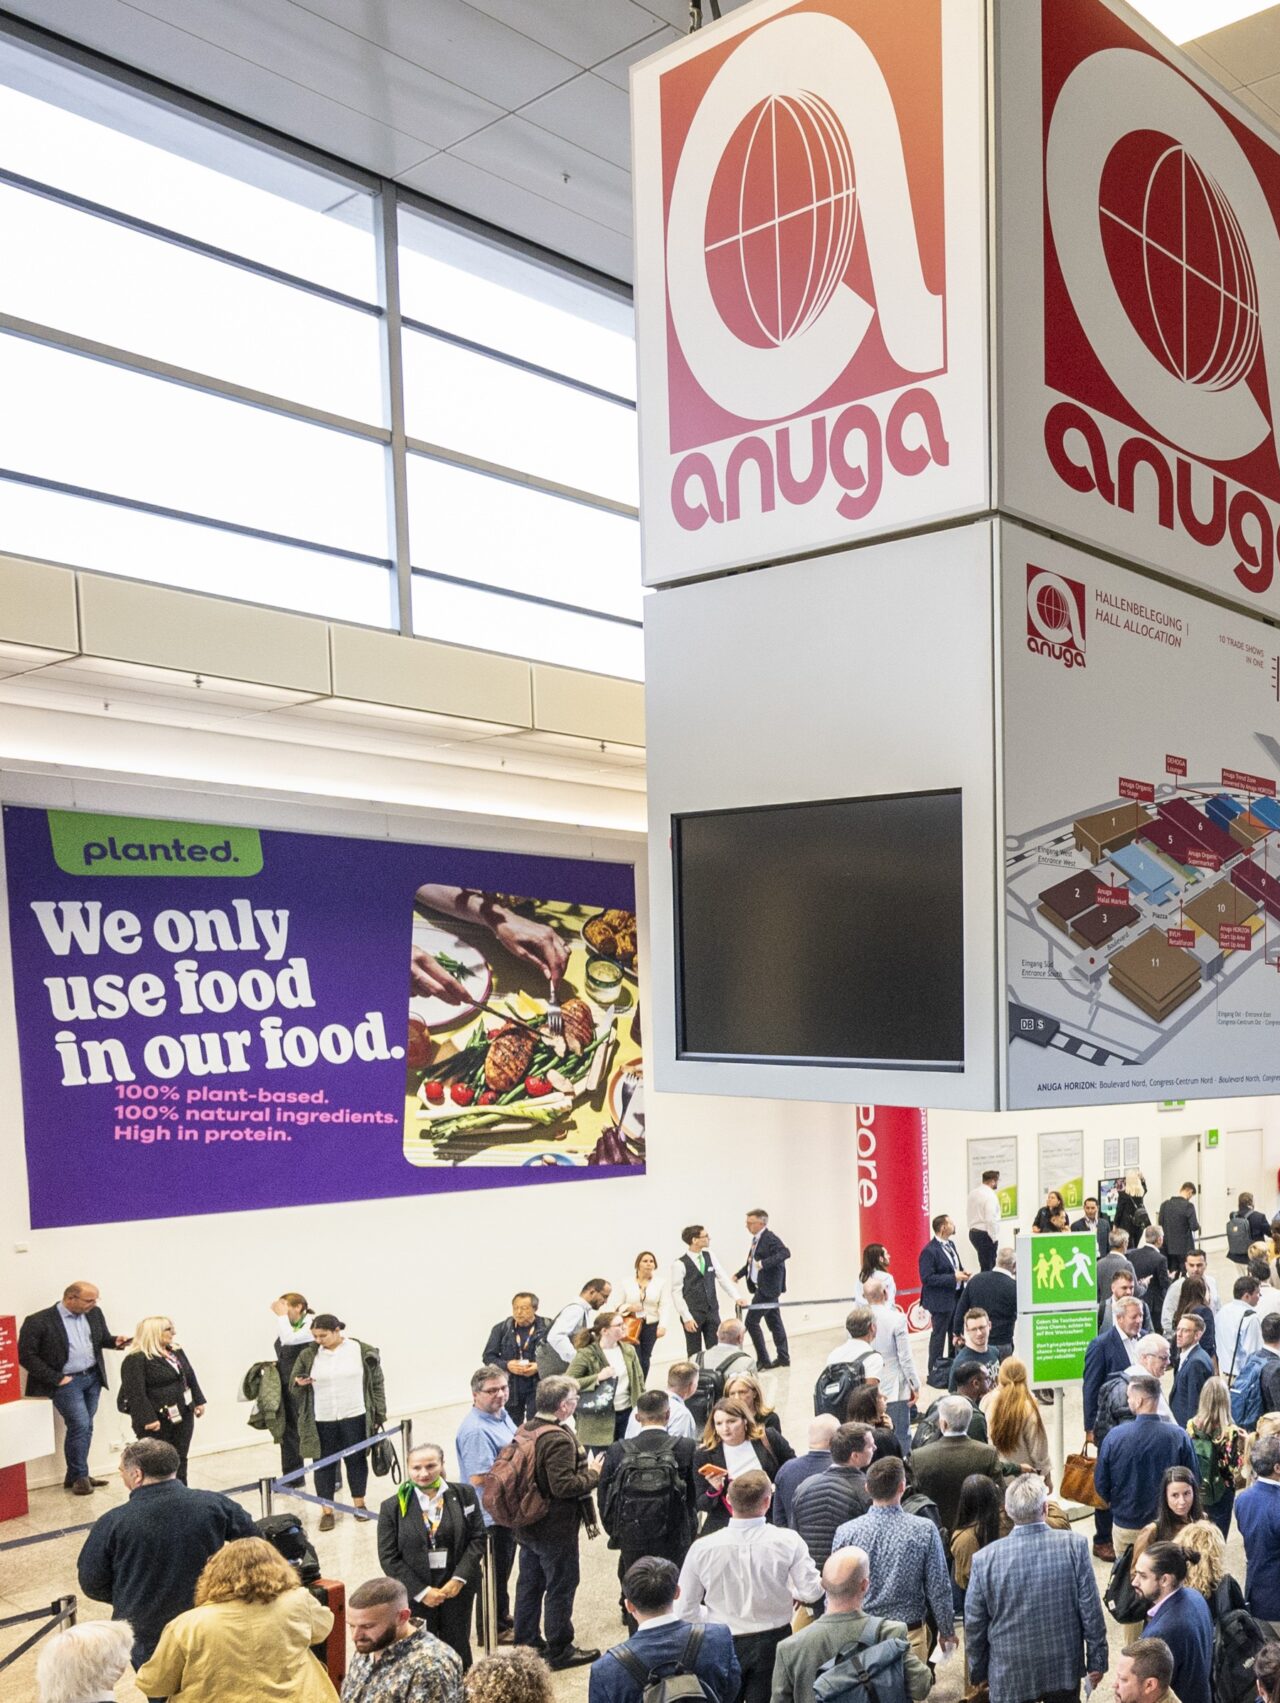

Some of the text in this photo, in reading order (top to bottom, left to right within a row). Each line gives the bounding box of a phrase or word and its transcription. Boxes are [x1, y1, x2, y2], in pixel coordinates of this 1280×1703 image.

[670, 388, 950, 532] anuga
[1096, 590, 1182, 631] HALLENBELEGUNG
[1096, 609, 1182, 647] HALL ALLOCATION
[1219, 635, 1264, 657] 10 TRADE SHOWS
[1027, 639, 1086, 668] anuga
[1246, 655, 1253, 665] IN
[1121, 780, 1152, 792] Anuga Organic
[1112, 818, 1115, 826] 1
[1199, 823, 1203, 831] 6
[1168, 835, 1172, 844] 5
[83, 836, 239, 865] planted.
[1139, 862, 1143, 870] 4
[1075, 888, 1080, 897] 2
[1217, 904, 1225, 912] 10
[1102, 914, 1107, 923] 3
[1152, 912, 1168, 920] Piazza
[31, 899, 290, 961] We only
[1022, 960, 1043, 969] Eingang
[1152, 959, 1159, 967] 11
[1022, 969, 1046, 977] Entrance
[44, 959, 315, 1022] use food
[1021, 1019, 1034, 1030] DB
[55, 1012, 405, 1087] in our food.
[1037, 1082, 1062, 1091] ANUGA
[1064, 1082, 1097, 1090] HORIZON:
[1099, 1080, 1129, 1089] Boulevard
[1131, 1080, 1147, 1088] Nord,
[115, 1084, 329, 1105] 100% plant-based.
[115, 1105, 399, 1126] 100% natural ingredients.
[114, 1126, 292, 1143] High in protein.
[920, 1170, 930, 1216] today!
